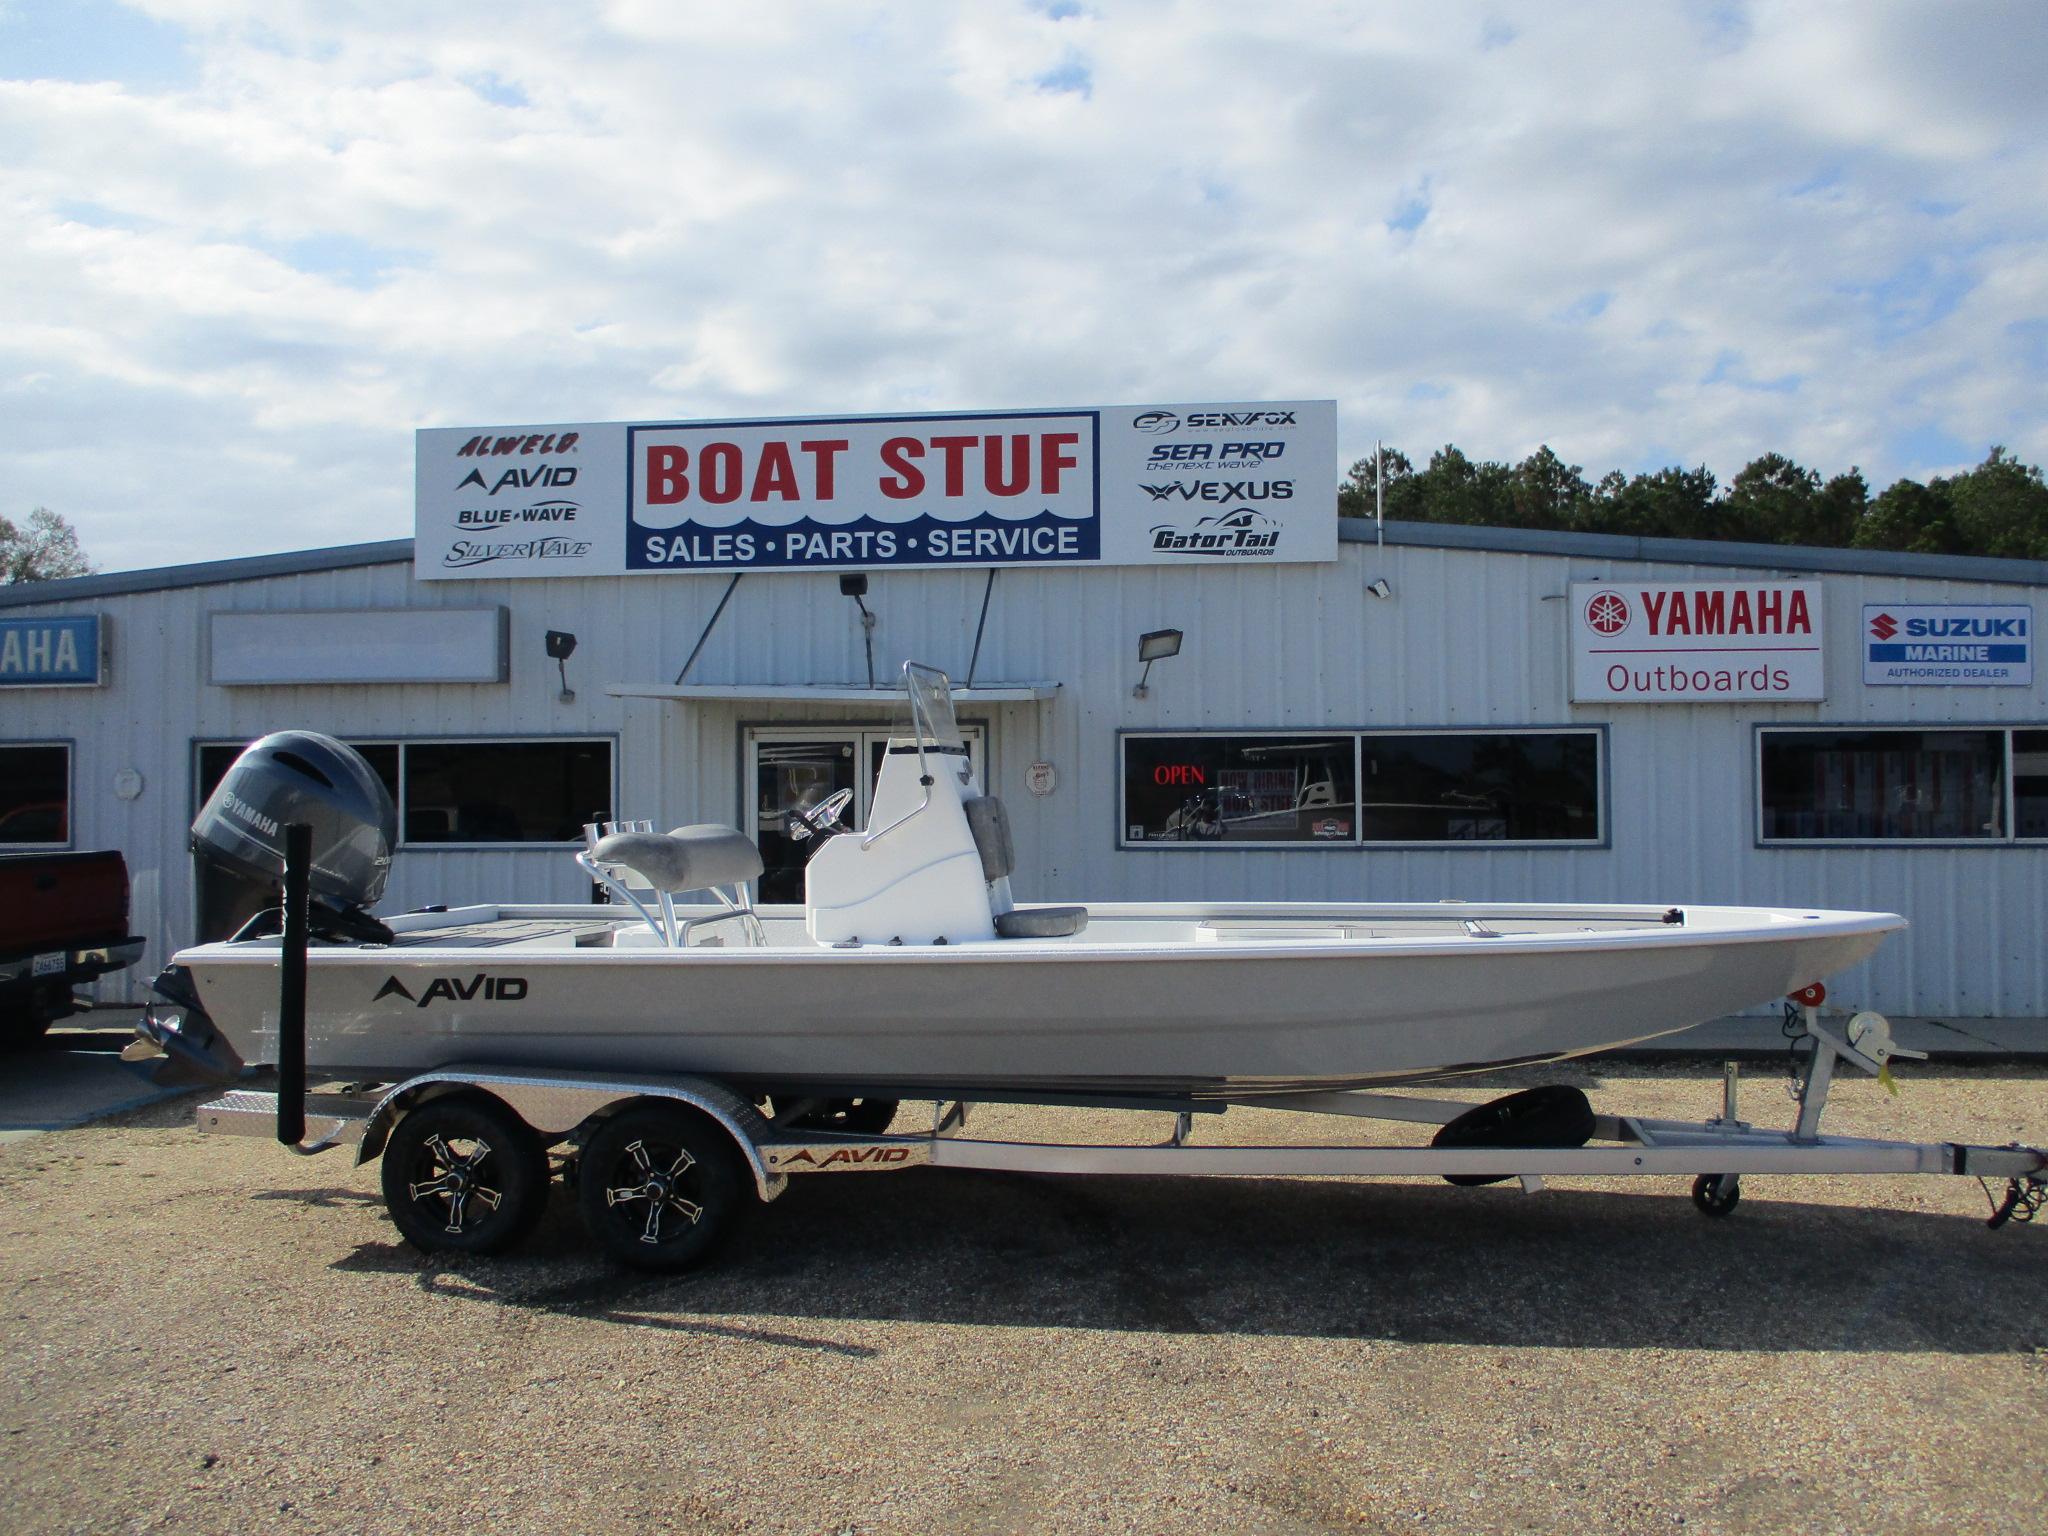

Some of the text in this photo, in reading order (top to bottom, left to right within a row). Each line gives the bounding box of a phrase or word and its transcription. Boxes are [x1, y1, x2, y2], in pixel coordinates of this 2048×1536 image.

[456, 432, 579, 458] ALWELD
[1147, 442, 1285, 461] SEA PRO
[647, 433, 1079, 505] BOAT STUF
[1146, 460, 1261, 471] the next wave
[488, 464, 577, 495] AVID
[1174, 480, 1294, 503] VEXUS
[646, 527, 1079, 564] SALES PARTS SERVICE
[1153, 530, 1280, 548] GatorTail
[1226, 549, 1275, 557] OUTBOARDS
[1641, 590, 1812, 636] YAMAHA
[1906, 618, 2026, 637] SUZUKI
[0, 629, 79, 673] AHA
[1905, 645, 1989, 662] MARINE
[1607, 664, 1790, 692] Outboards
[1887, 668, 2009, 679] AUTHORIZED DEALER
[1154, 765, 1205, 785] OPEN
[233, 799, 279, 838] YAMAHA
[417, 974, 528, 1007] AVID
[817, 1147, 910, 1168] AVID
